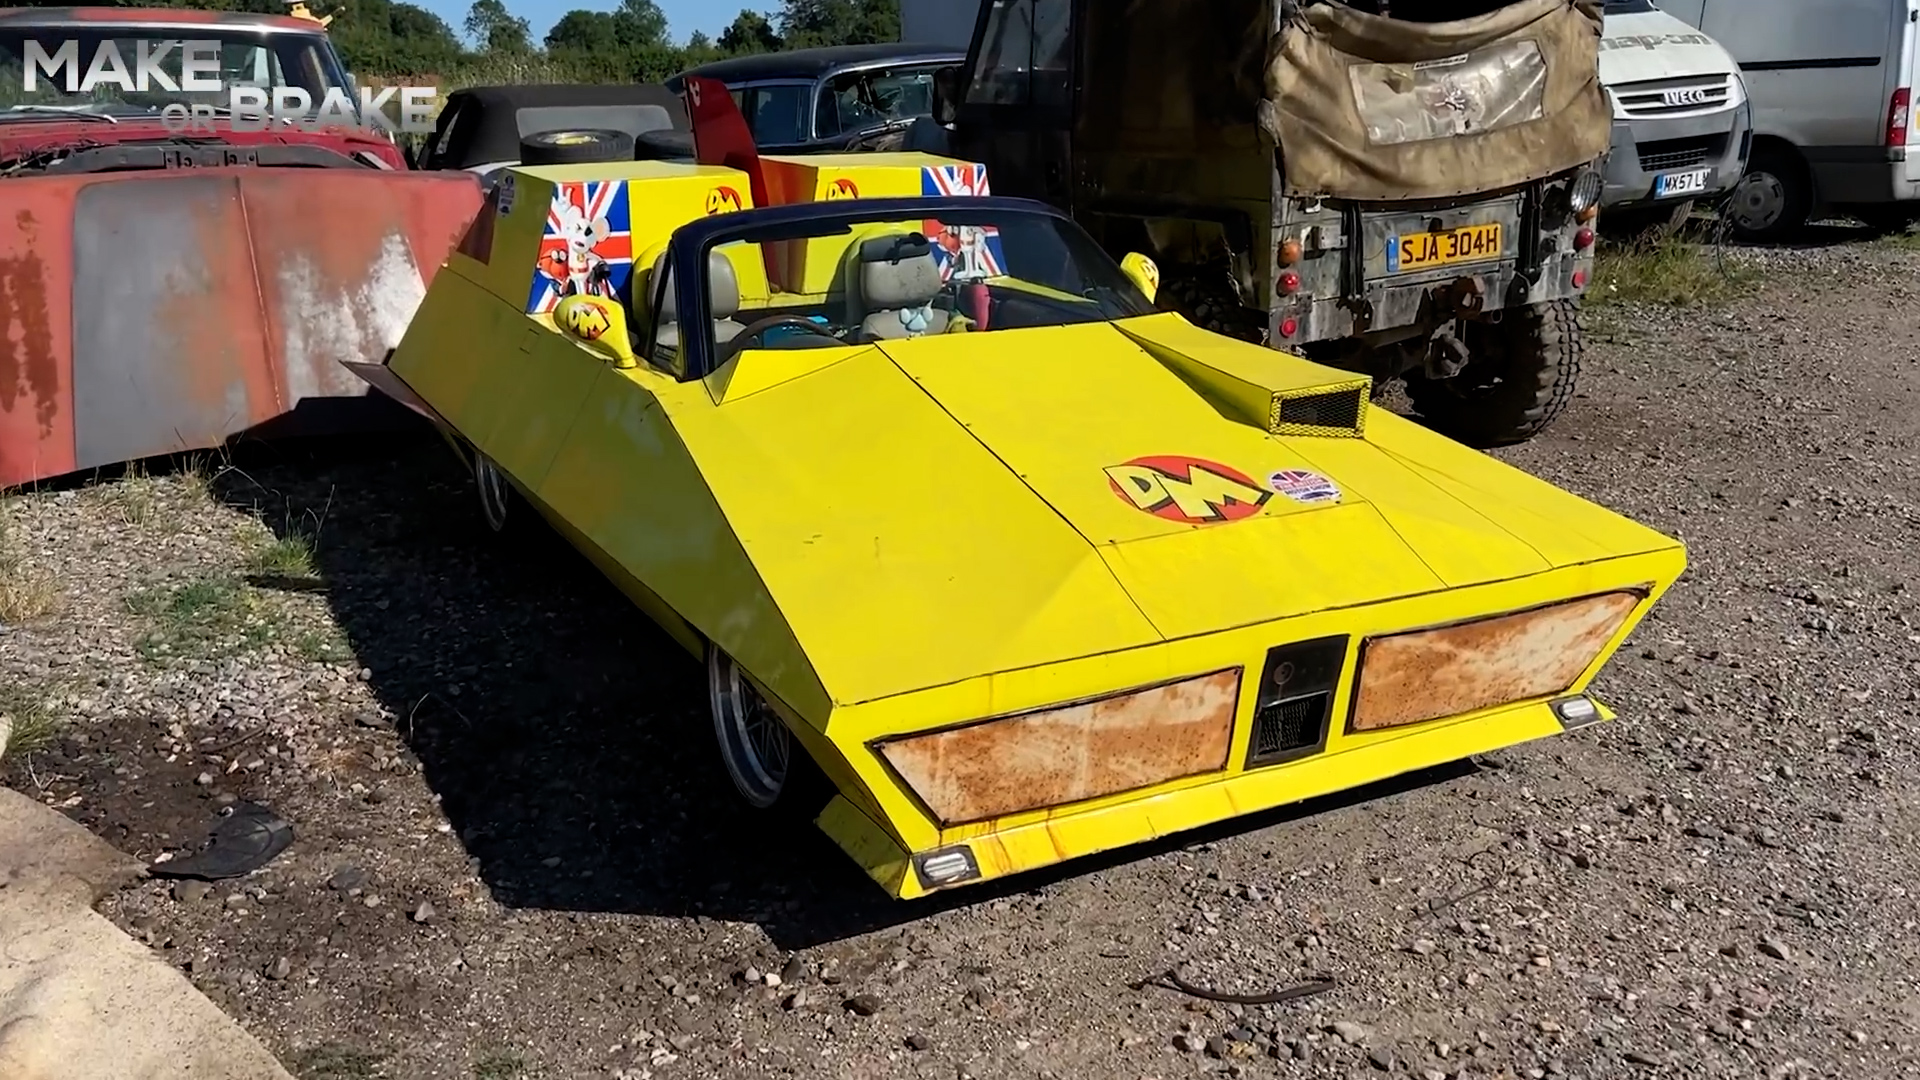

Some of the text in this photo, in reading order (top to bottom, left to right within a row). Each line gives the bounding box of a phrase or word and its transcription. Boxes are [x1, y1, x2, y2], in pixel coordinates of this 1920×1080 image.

[1598, 34, 1712, 51] nap-on
[1663, 90, 1706, 106] IVECO
[1664, 173, 1693, 191] MX57
[1402, 227, 1498, 264] SJA 304H
[567, 304, 610, 339] DM
[1102, 463, 1273, 522] DM
